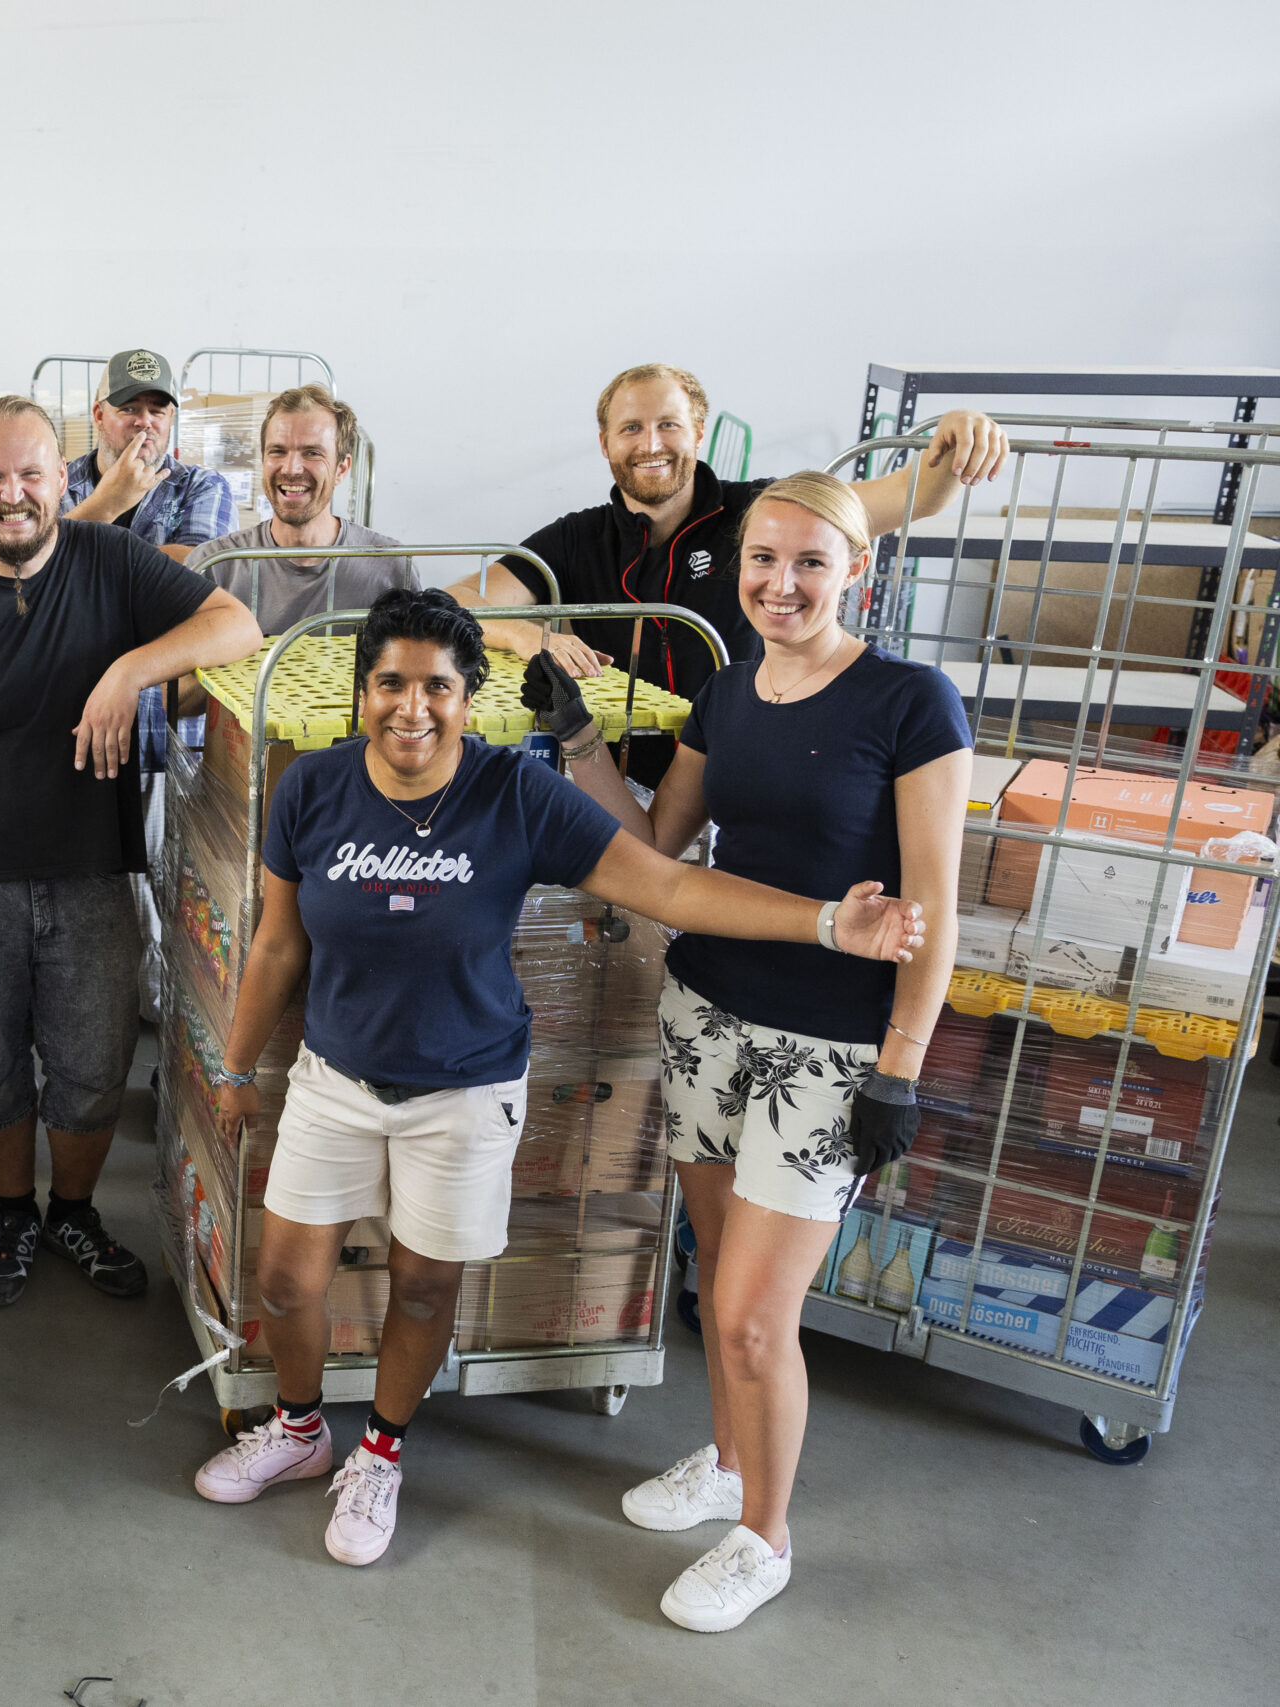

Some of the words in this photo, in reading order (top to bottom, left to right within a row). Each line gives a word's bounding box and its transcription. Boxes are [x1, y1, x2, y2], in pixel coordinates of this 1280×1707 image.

[327, 841, 475, 884] Hollister
[361, 881, 441, 895] ORLANDO
[1074, 1148, 1146, 1167] HALBROCKEN
[996, 1215, 1125, 1256] Rotkäpphen
[1049, 1255, 1119, 1275] HALBROCKEN
[928, 1297, 1032, 1330] Durslöscher
[1064, 1335, 1106, 1358] RUCHTIG,
